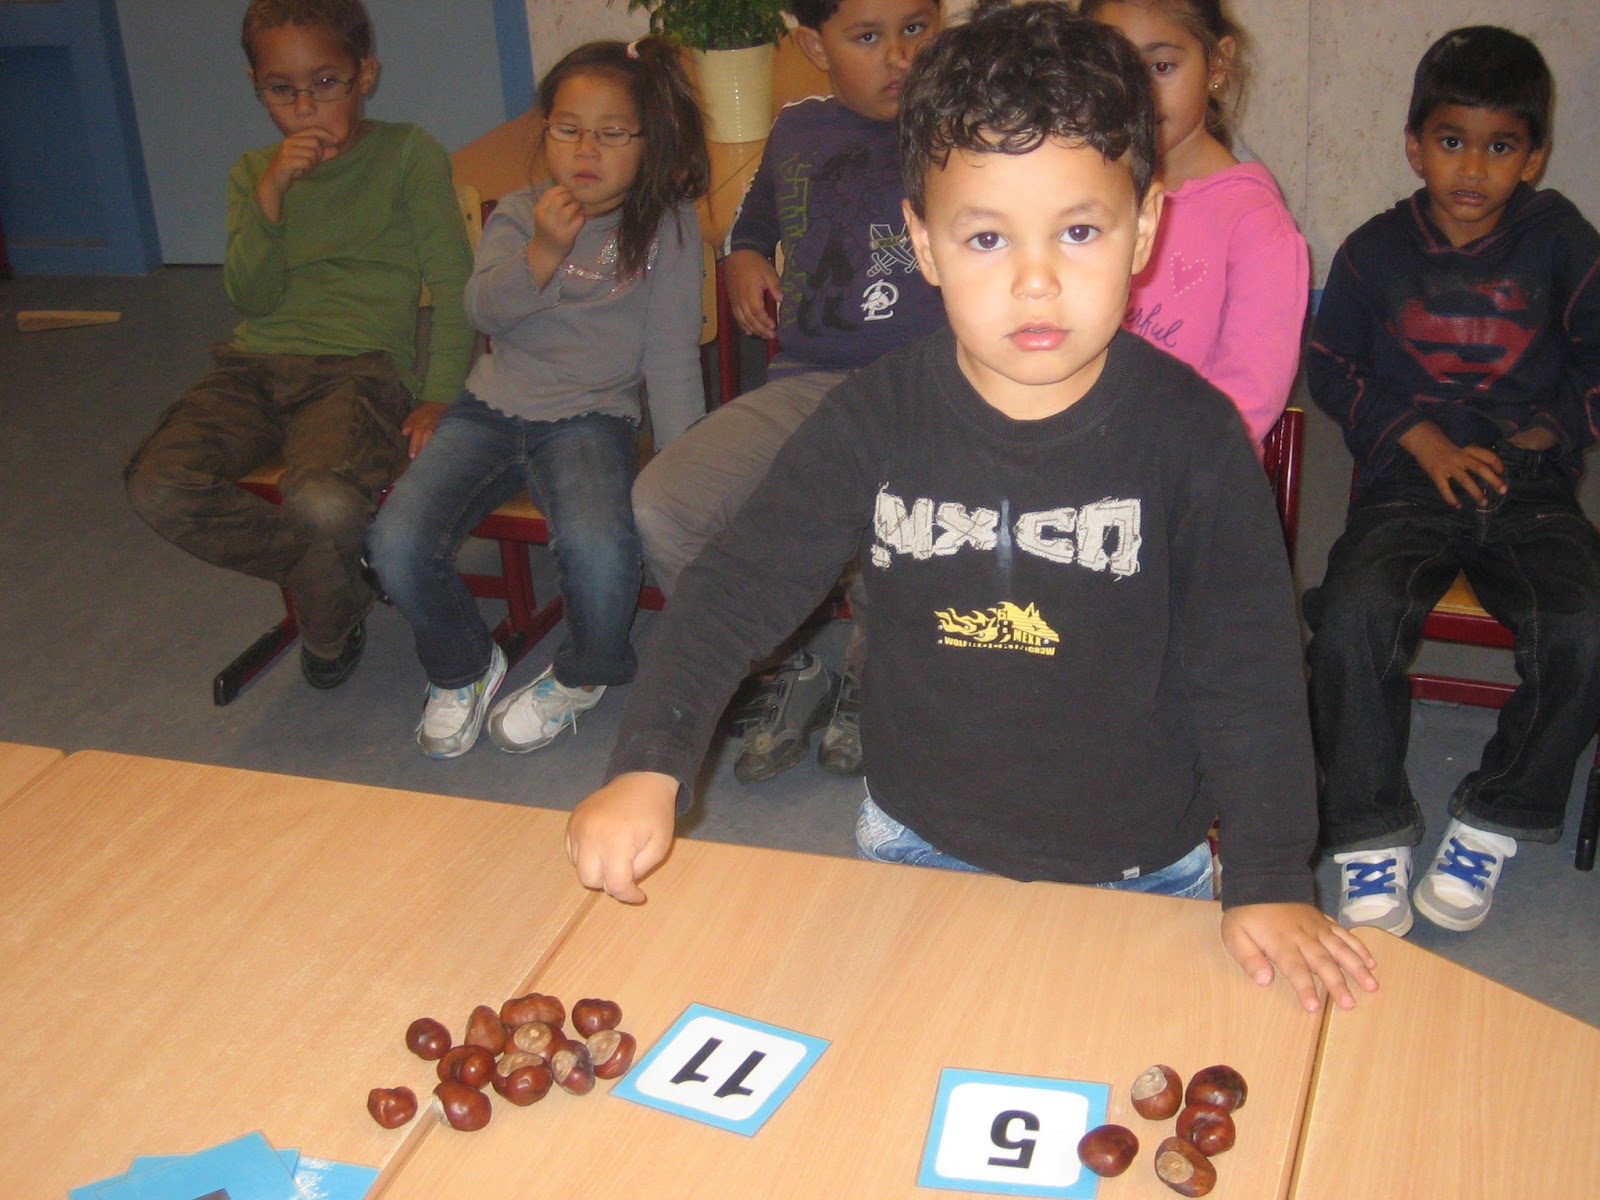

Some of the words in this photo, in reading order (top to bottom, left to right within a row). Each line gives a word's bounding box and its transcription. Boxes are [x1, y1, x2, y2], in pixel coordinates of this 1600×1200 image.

[1013, 628, 1042, 646] MEXX
[669, 1036, 767, 1099] 11
[987, 1109, 1041, 1169] 5
